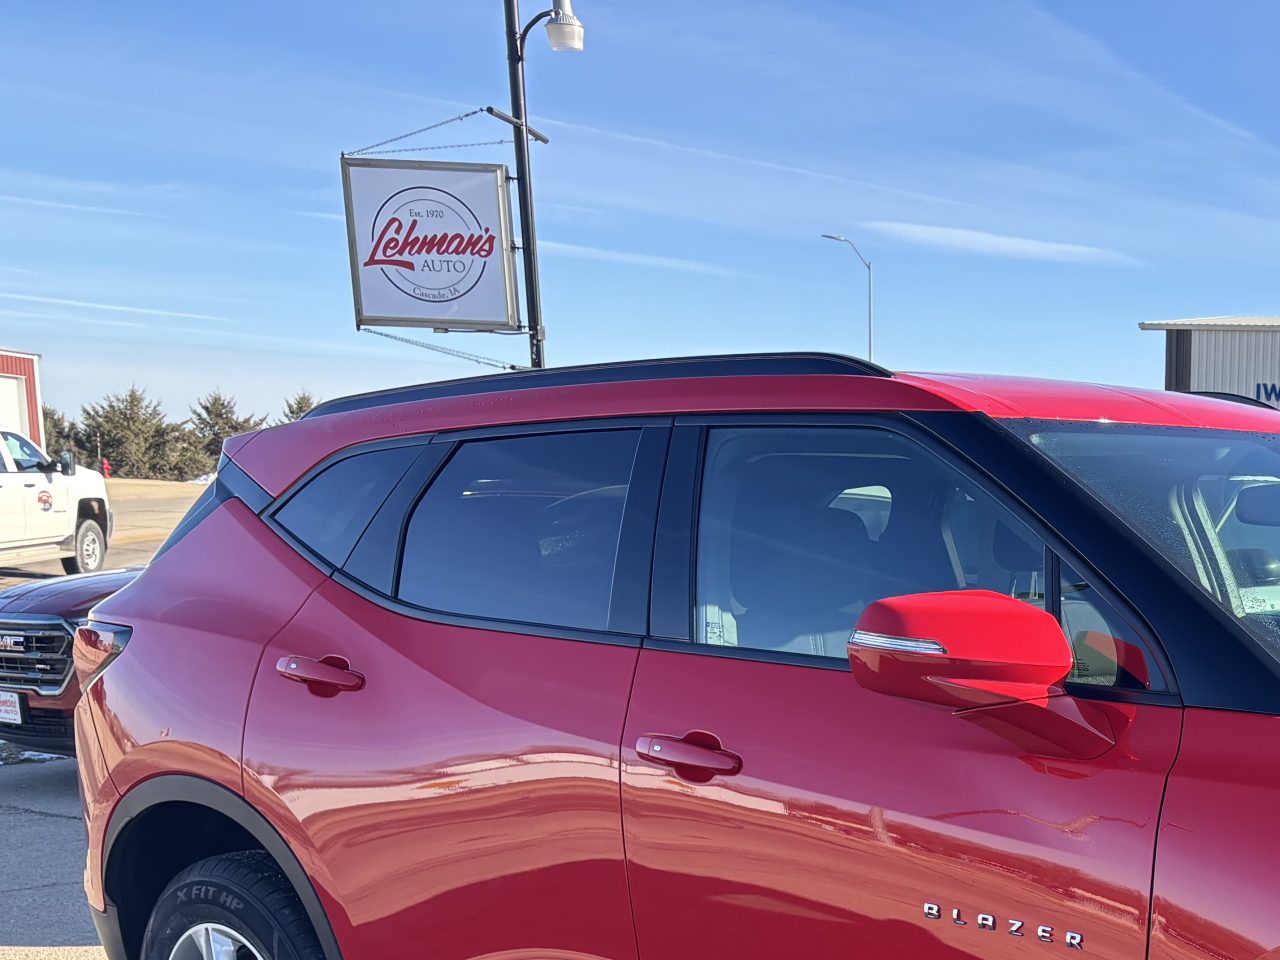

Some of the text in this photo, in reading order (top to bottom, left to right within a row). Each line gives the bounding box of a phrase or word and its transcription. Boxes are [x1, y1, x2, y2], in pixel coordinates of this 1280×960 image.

[426, 209, 444, 219] 1970
[363, 217, 496, 271] Lehman's
[421, 259, 466, 273] AUTO
[449, 286, 460, 297] IA
[0, 636, 25, 651] MC
[175, 885, 245, 911] X FIT HP
[923, 902, 1083, 951] BLAZER
